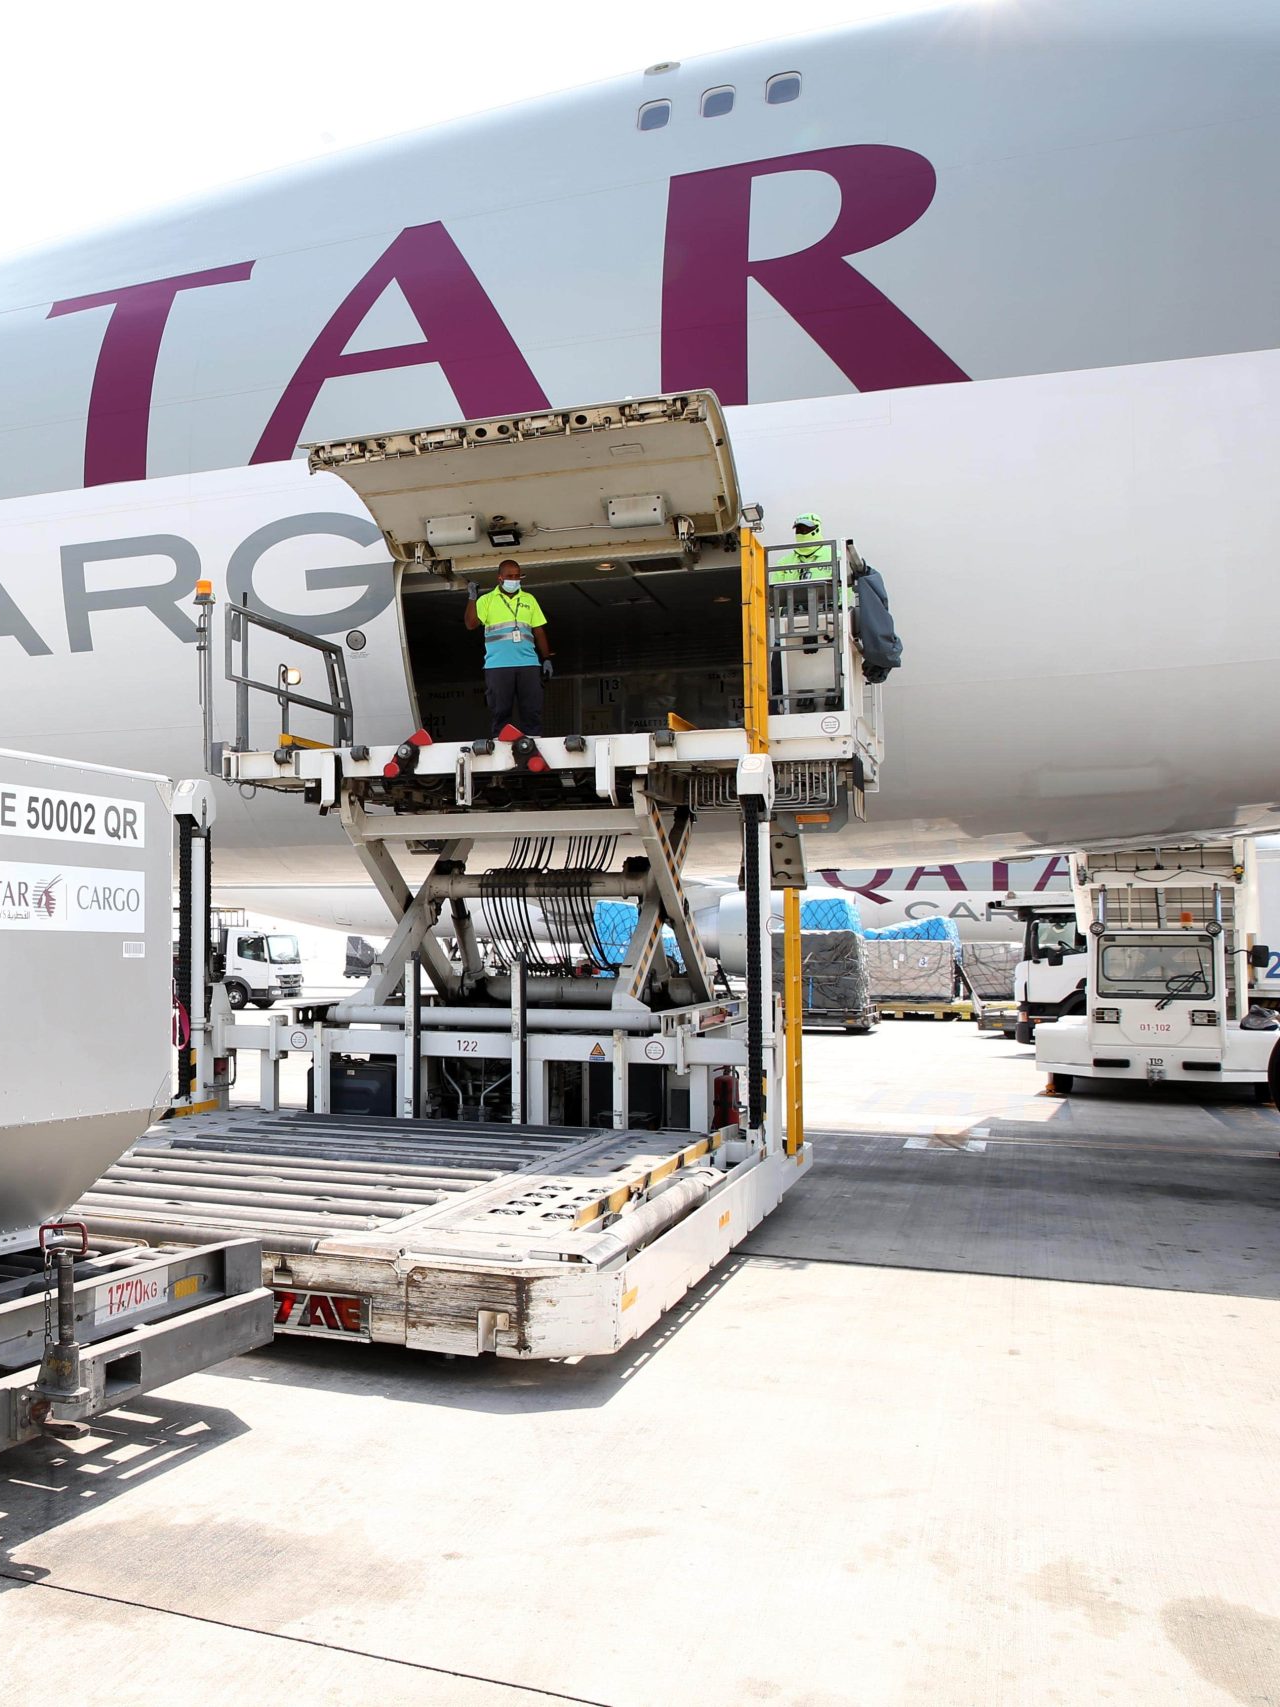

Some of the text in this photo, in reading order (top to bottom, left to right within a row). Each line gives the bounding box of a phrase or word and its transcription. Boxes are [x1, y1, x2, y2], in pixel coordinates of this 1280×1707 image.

[604, 679, 620, 690] 13
[27, 796, 96, 835] 50002
[104, 805, 138, 841] QR
[76, 885, 140, 912] CARGO
[1139, 1023, 1171, 1032] 01-102
[457, 1039, 478, 1052] 122
